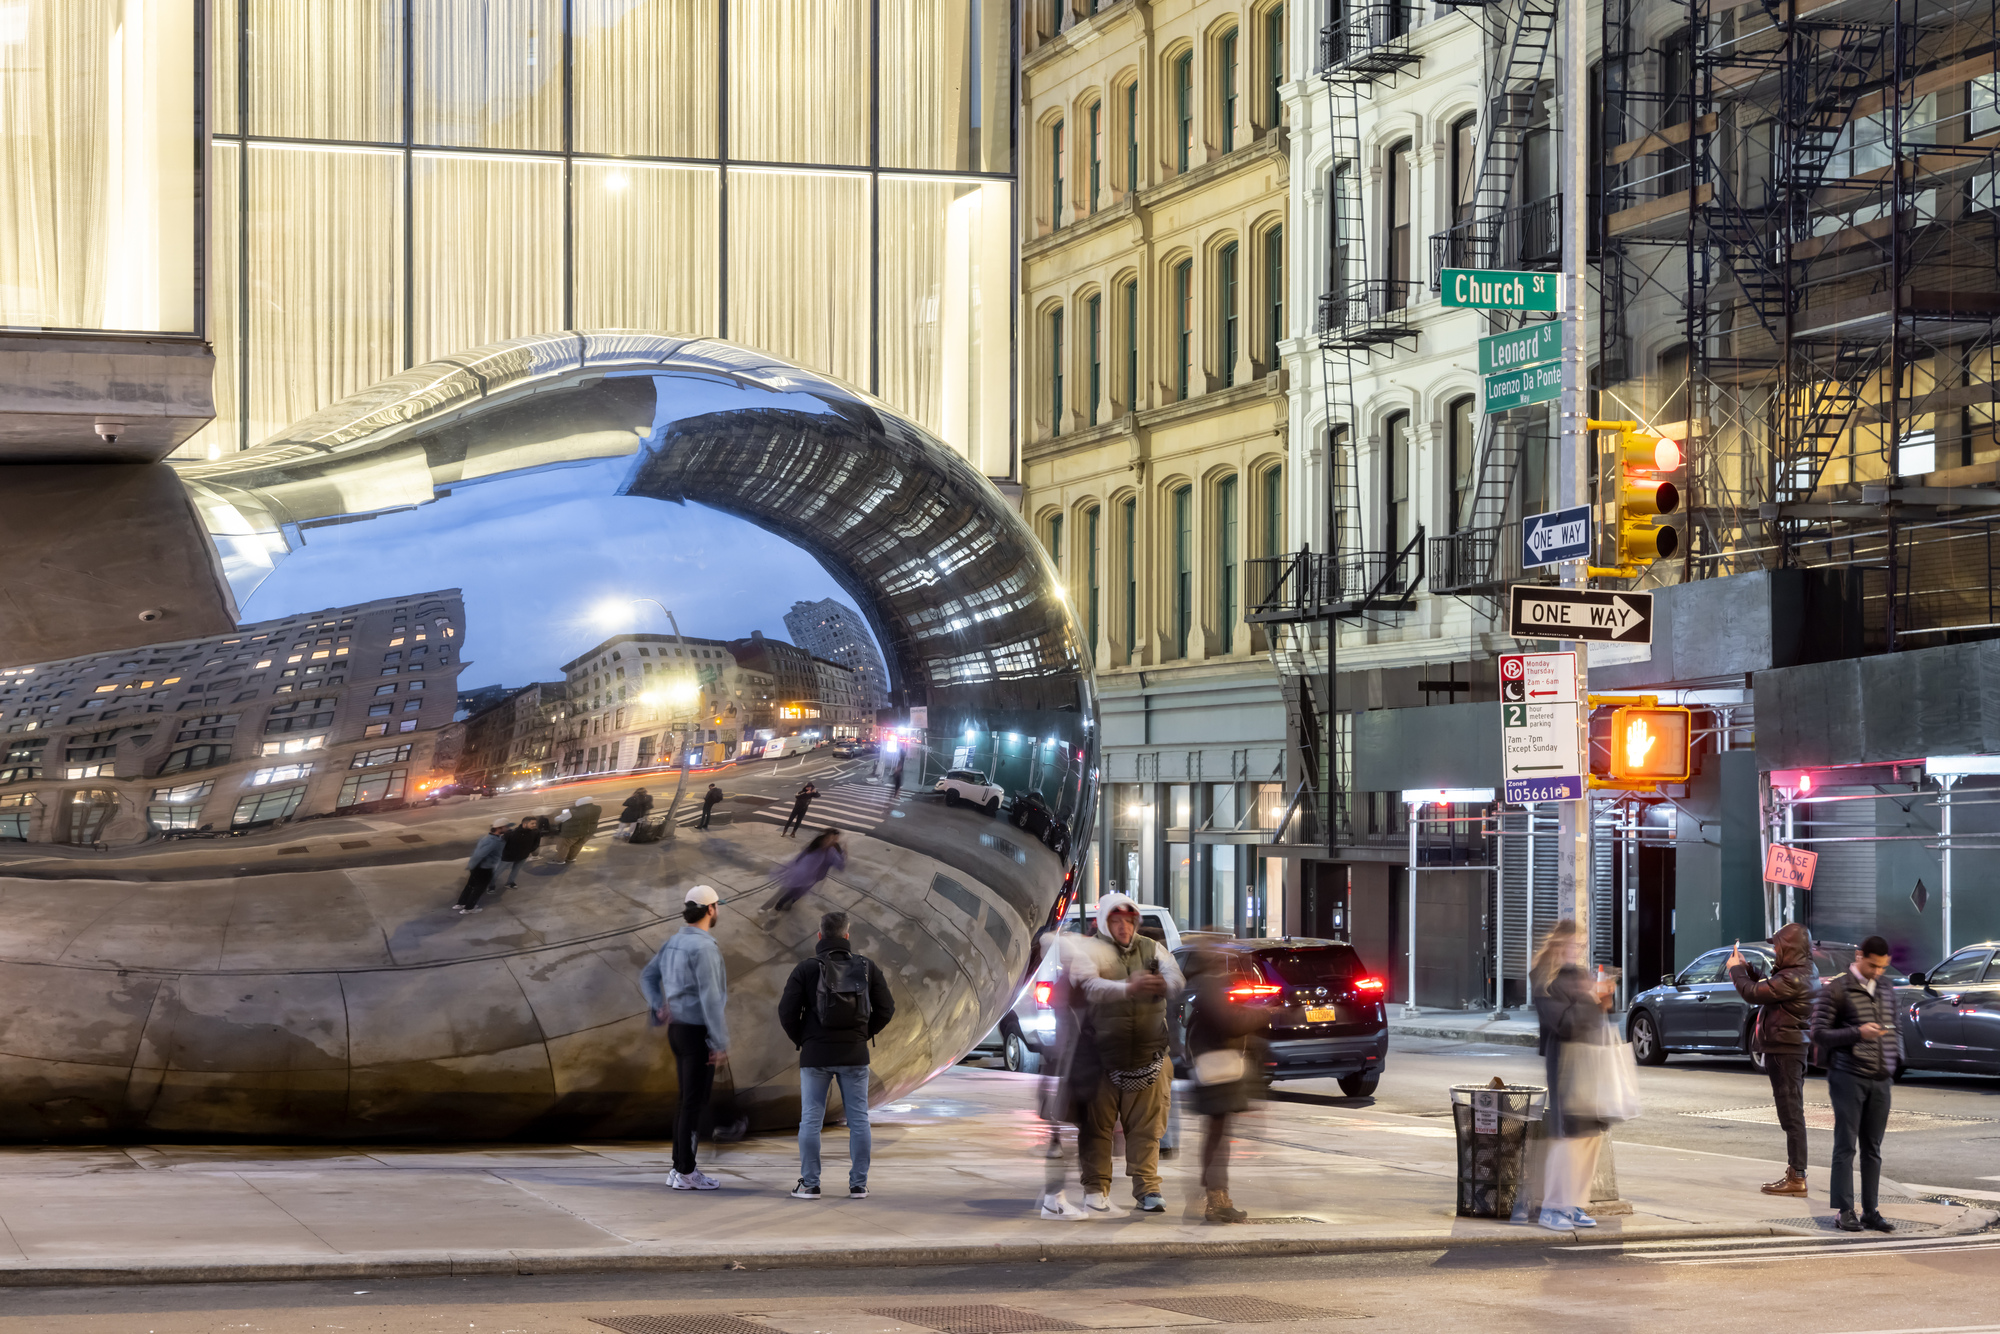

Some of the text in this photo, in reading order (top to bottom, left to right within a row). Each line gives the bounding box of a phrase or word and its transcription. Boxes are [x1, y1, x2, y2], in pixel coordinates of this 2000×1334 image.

[1455, 274, 1545, 305] Church St
[1491, 326, 1551, 367] Leonard St
[1488, 366, 1562, 399] Lorenzo Da Ponte
[1520, 394, 1530, 404] Way
[1533, 523, 1581, 550] ONE WAY
[1532, 603, 1631, 627] ONE WAY
[1509, 706, 1521, 726] 2
[1529, 720, 1552, 728] parking
[1507, 735, 1522, 743] 7am
[1528, 735, 1543, 744] 7pm
[1508, 744, 1558, 753] Except Sunday
[1508, 786, 1554, 801] 105661
[1776, 852, 1809, 868] RAISE
[1774, 867, 1805, 882] PLOW
